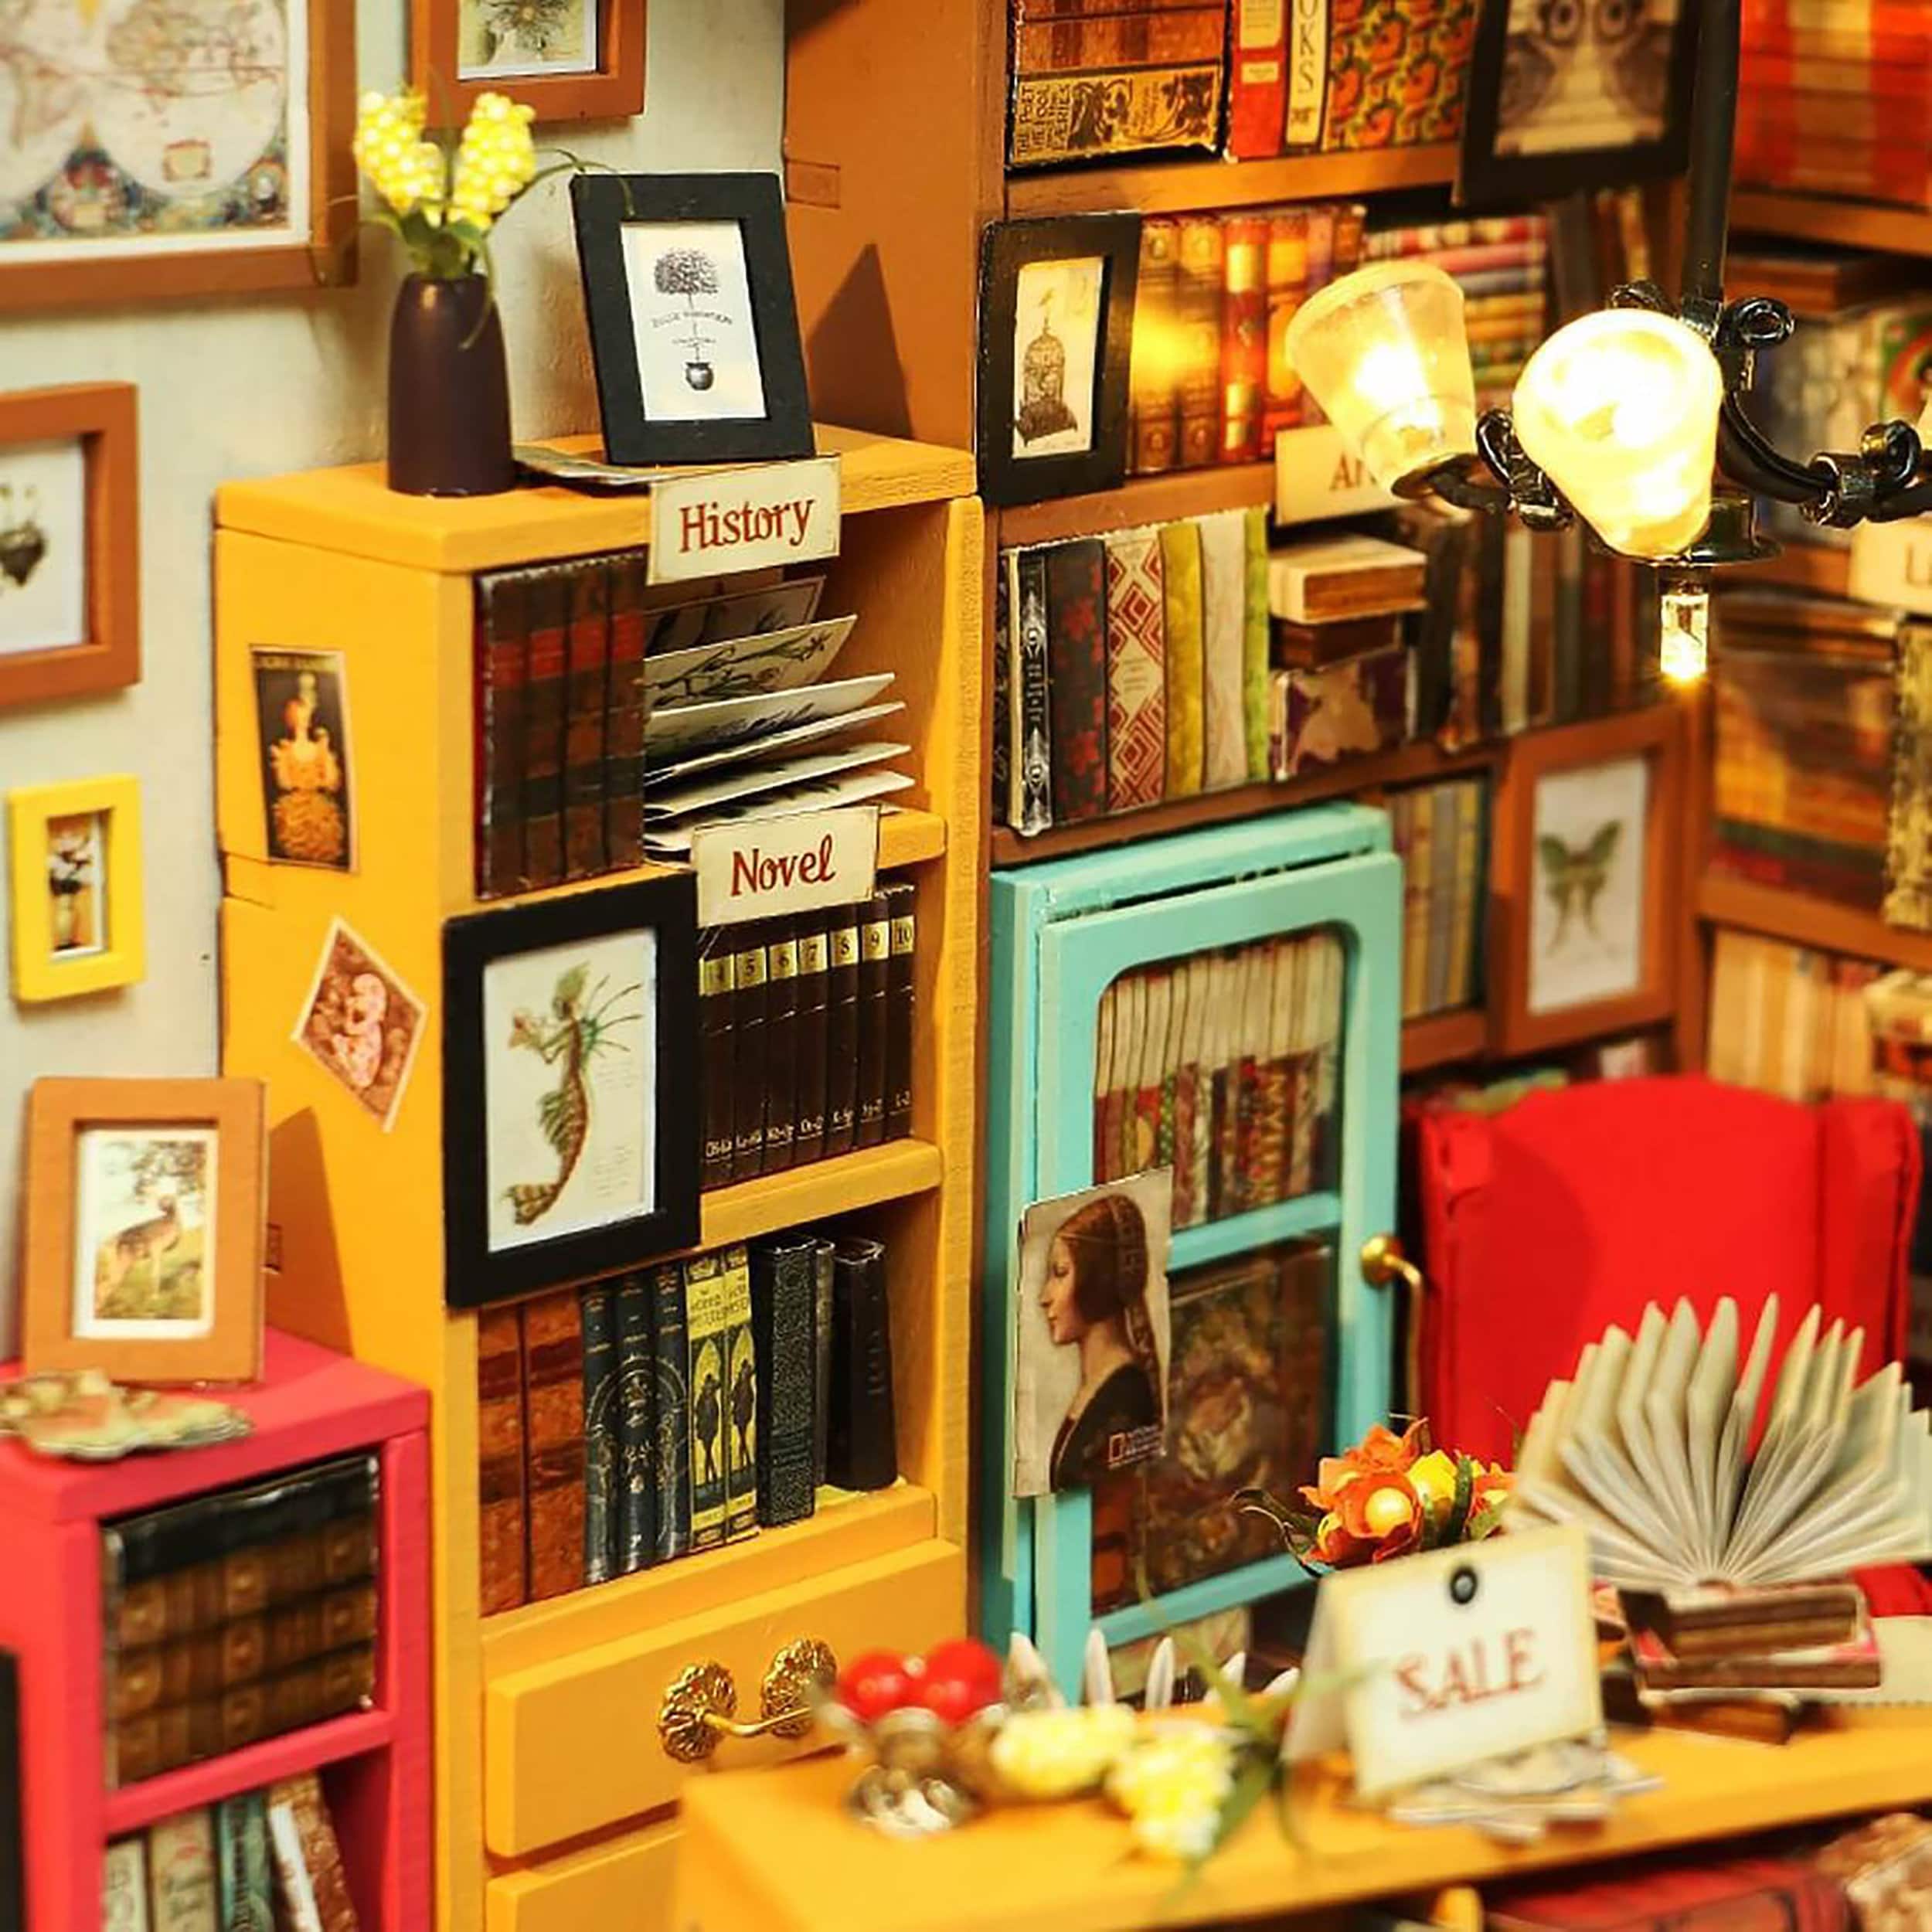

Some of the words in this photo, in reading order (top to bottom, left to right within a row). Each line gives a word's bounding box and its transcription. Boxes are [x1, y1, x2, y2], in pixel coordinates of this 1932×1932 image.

[1019, 85, 1034, 123] POET
[679, 499, 815, 553] History
[730, 833, 836, 897] Novel
[840, 936, 851, 955] 8
[896, 923, 912, 945] 10
[1393, 1626, 1549, 1719] SALE
